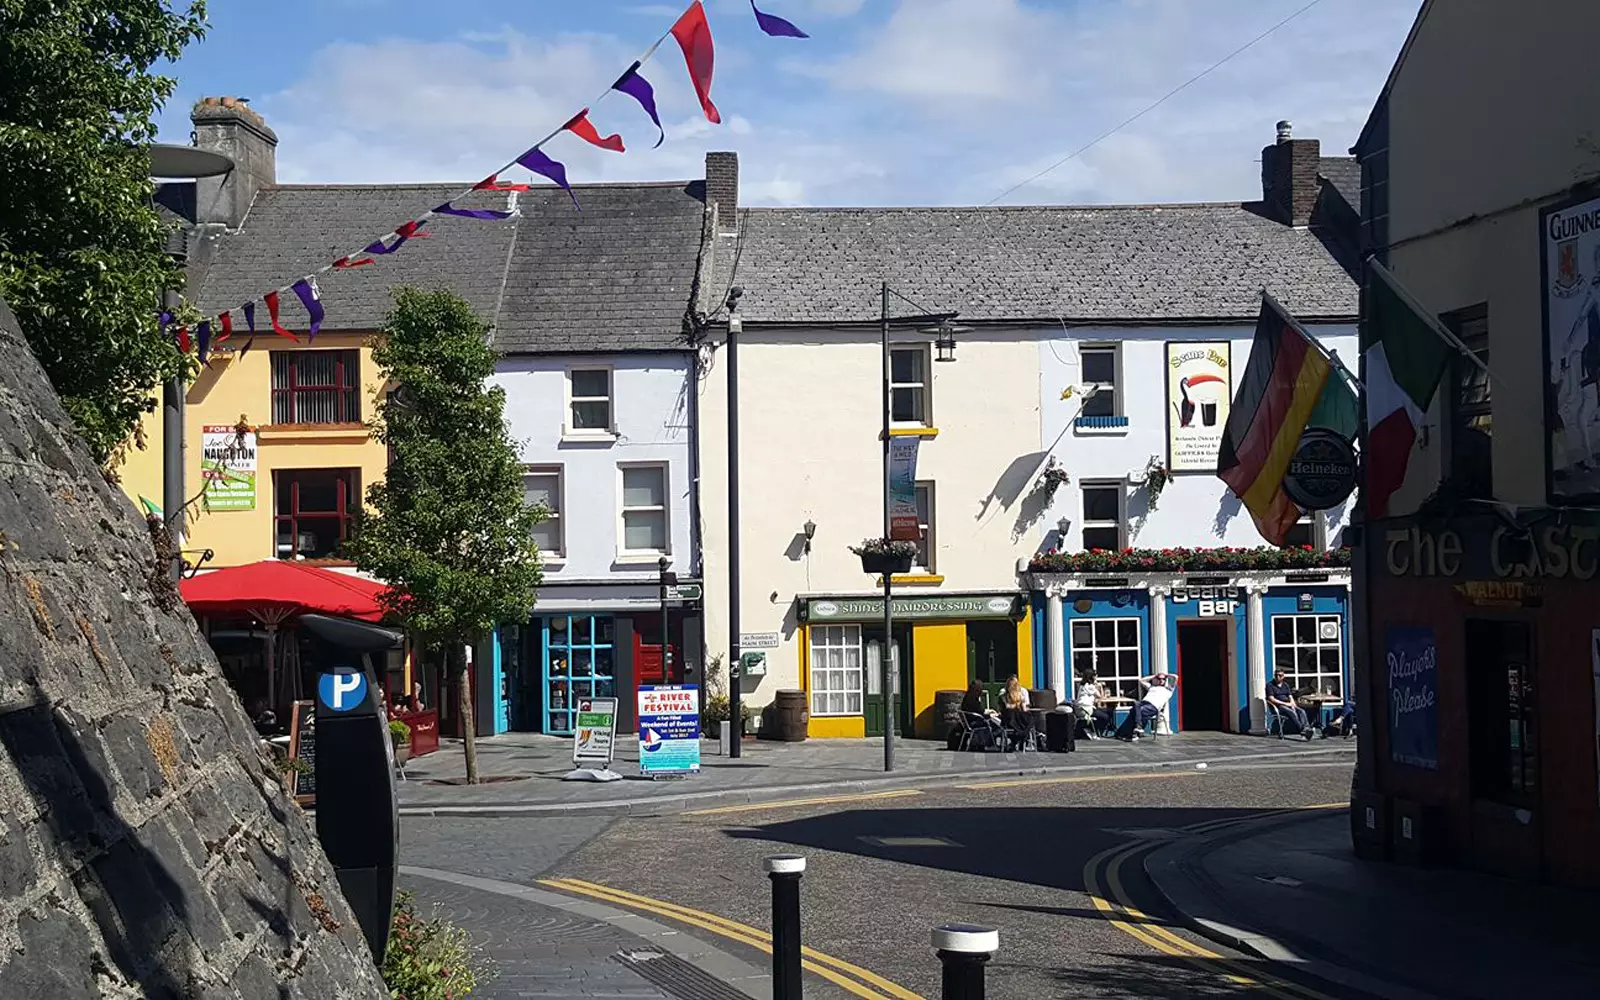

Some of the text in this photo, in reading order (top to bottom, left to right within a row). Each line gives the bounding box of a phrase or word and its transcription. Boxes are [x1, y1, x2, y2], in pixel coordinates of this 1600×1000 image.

[1171, 348, 1228, 369] Seans Bar
[205, 438, 223, 447] Joe
[1291, 462, 1351, 475] Heineken
[1172, 586, 1239, 604] Seans
[1199, 600, 1240, 617] Bar
[333, 666, 361, 708] P
[660, 693, 691, 701] RIVER
[644, 703, 693, 712] FESTIVAL
